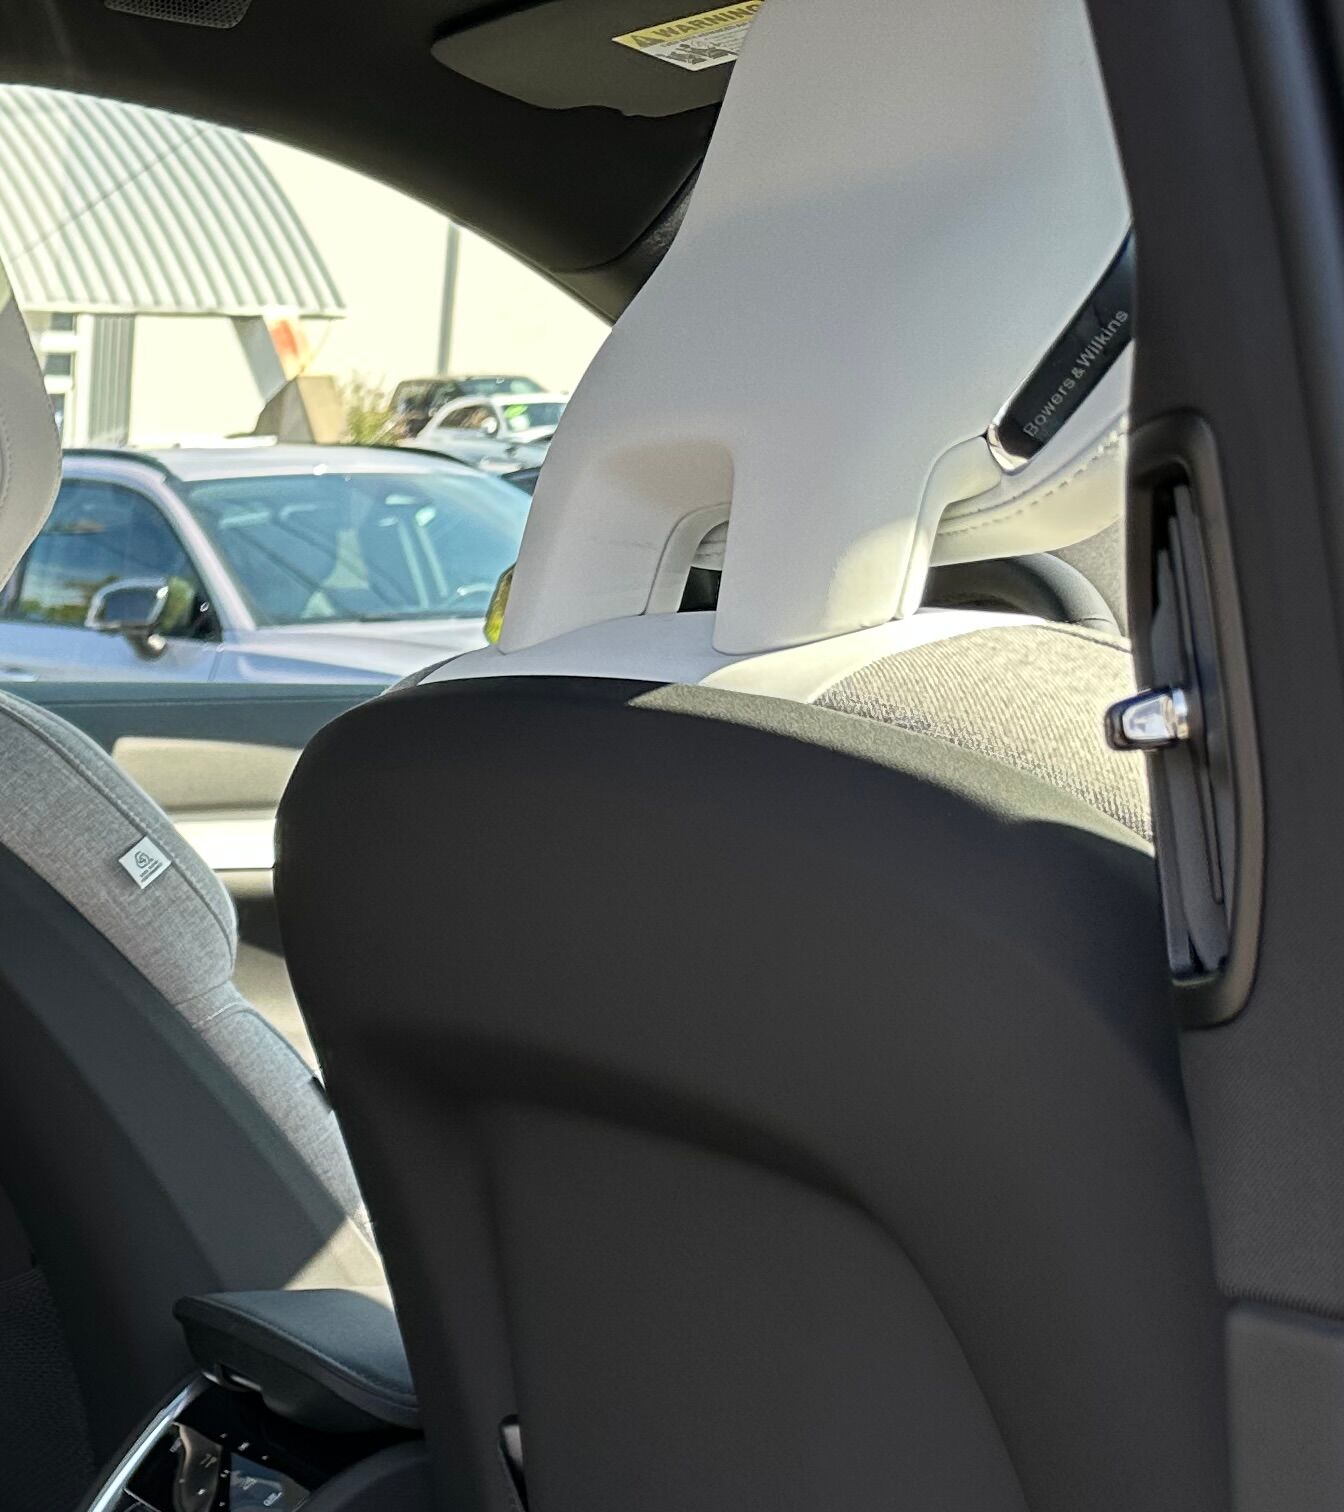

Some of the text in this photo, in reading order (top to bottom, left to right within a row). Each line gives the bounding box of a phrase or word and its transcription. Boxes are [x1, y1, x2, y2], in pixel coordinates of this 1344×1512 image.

[1023, 310, 1129, 438] Bowers & Wilkins
